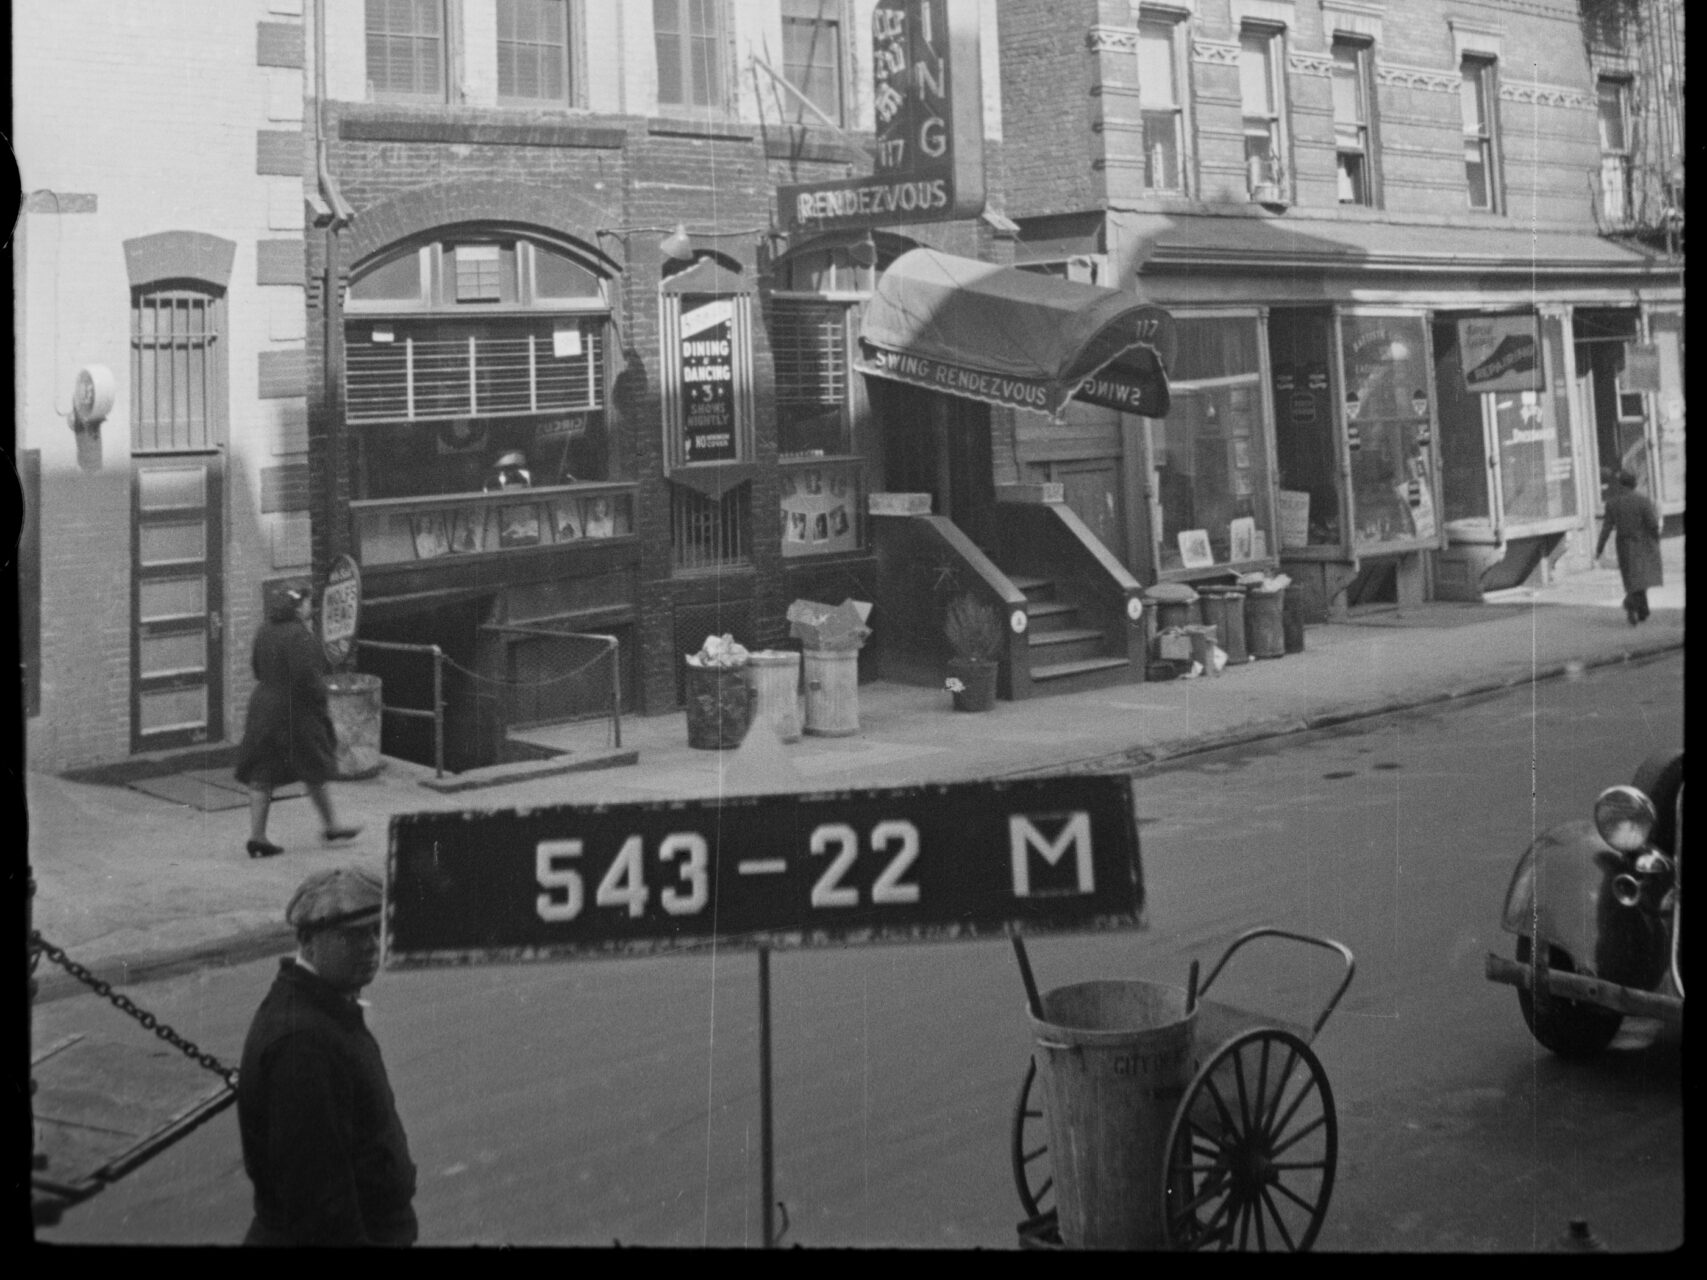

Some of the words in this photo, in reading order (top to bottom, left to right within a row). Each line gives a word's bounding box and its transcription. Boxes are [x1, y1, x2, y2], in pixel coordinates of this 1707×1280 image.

[796, 180, 948, 223] RENDEZVOUS
[1135, 320, 1160, 338] 117
[683, 341, 729, 357] DINING
[683, 365, 731, 383] DANCING
[875, 350, 931, 378] SWING
[935, 365, 1047, 405] RENDEZVOUS
[701, 384, 714, 402] 3
[1009, 810, 1095, 898] M
